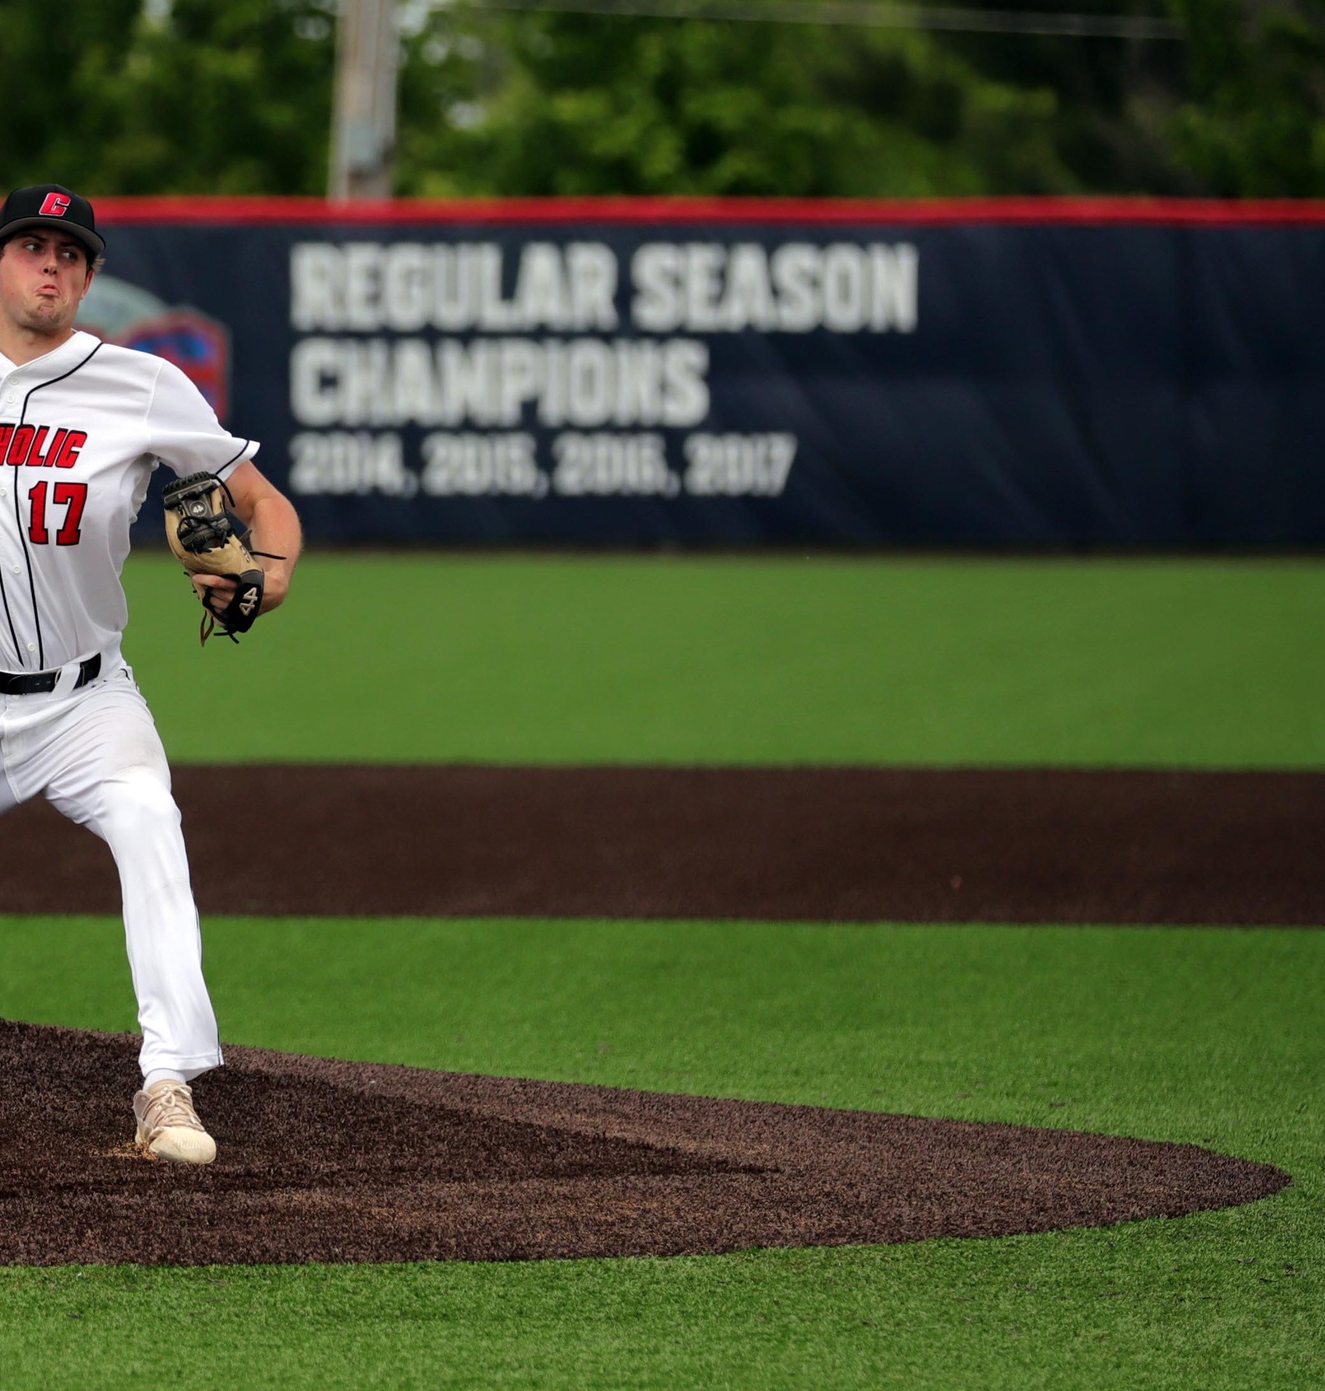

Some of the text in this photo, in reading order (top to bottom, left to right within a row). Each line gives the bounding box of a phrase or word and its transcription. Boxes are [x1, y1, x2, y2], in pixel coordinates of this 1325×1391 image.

[39, 192, 71, 216] C
[290, 243, 919, 332] REGULAR SEASON
[290, 338, 710, 427] CHAMPIONS
[289, 432, 797, 498] 2014, 2015, 2016, 2017
[28, 481, 88, 546] 17
[239, 587, 258, 617] 44
